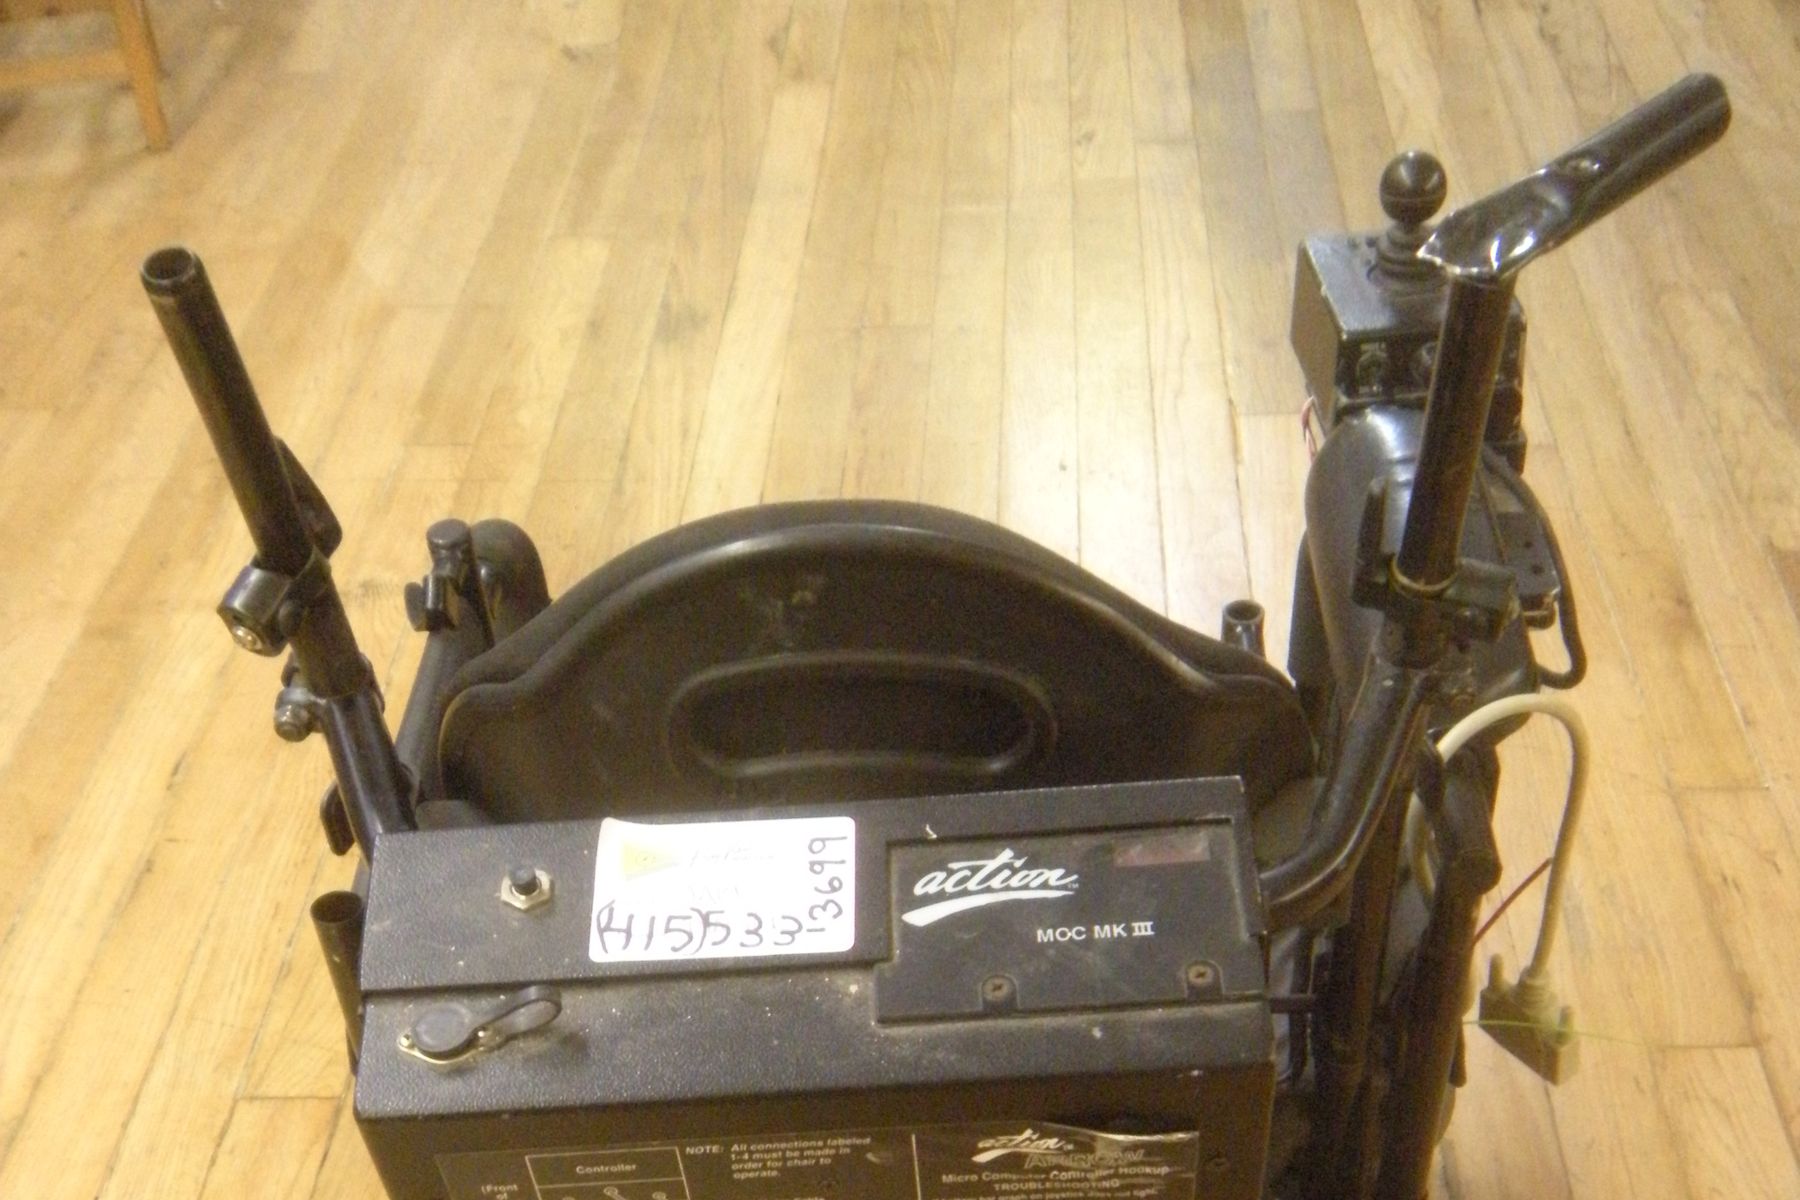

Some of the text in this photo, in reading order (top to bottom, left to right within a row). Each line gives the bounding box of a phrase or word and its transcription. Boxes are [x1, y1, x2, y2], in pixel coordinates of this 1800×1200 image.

[913, 848, 1078, 896] action
[1037, 922, 1155, 942] MOC MK III
[977, 1128, 1066, 1149] action
[686, 1138, 871, 1154] NOTE: All connections labeled
[752, 1151, 782, 1160] must
[785, 1150, 800, 1158] be
[803, 1148, 836, 1156] made
[839, 1146, 850, 1154] in
[576, 1164, 637, 1174] Controller
[731, 1161, 764, 1170] order
[766, 1160, 782, 1168] for
[786, 1158, 816, 1166] chair
[942, 1173, 978, 1183] Micro
[1050, 1168, 1115, 1180] Controller
[1118, 1165, 1170, 1176] Hookup
[482, 1184, 518, 1194] (Front
[994, 1179, 1120, 1191] TROUBLESHOOTING
[496, 1192, 508, 1200] of
